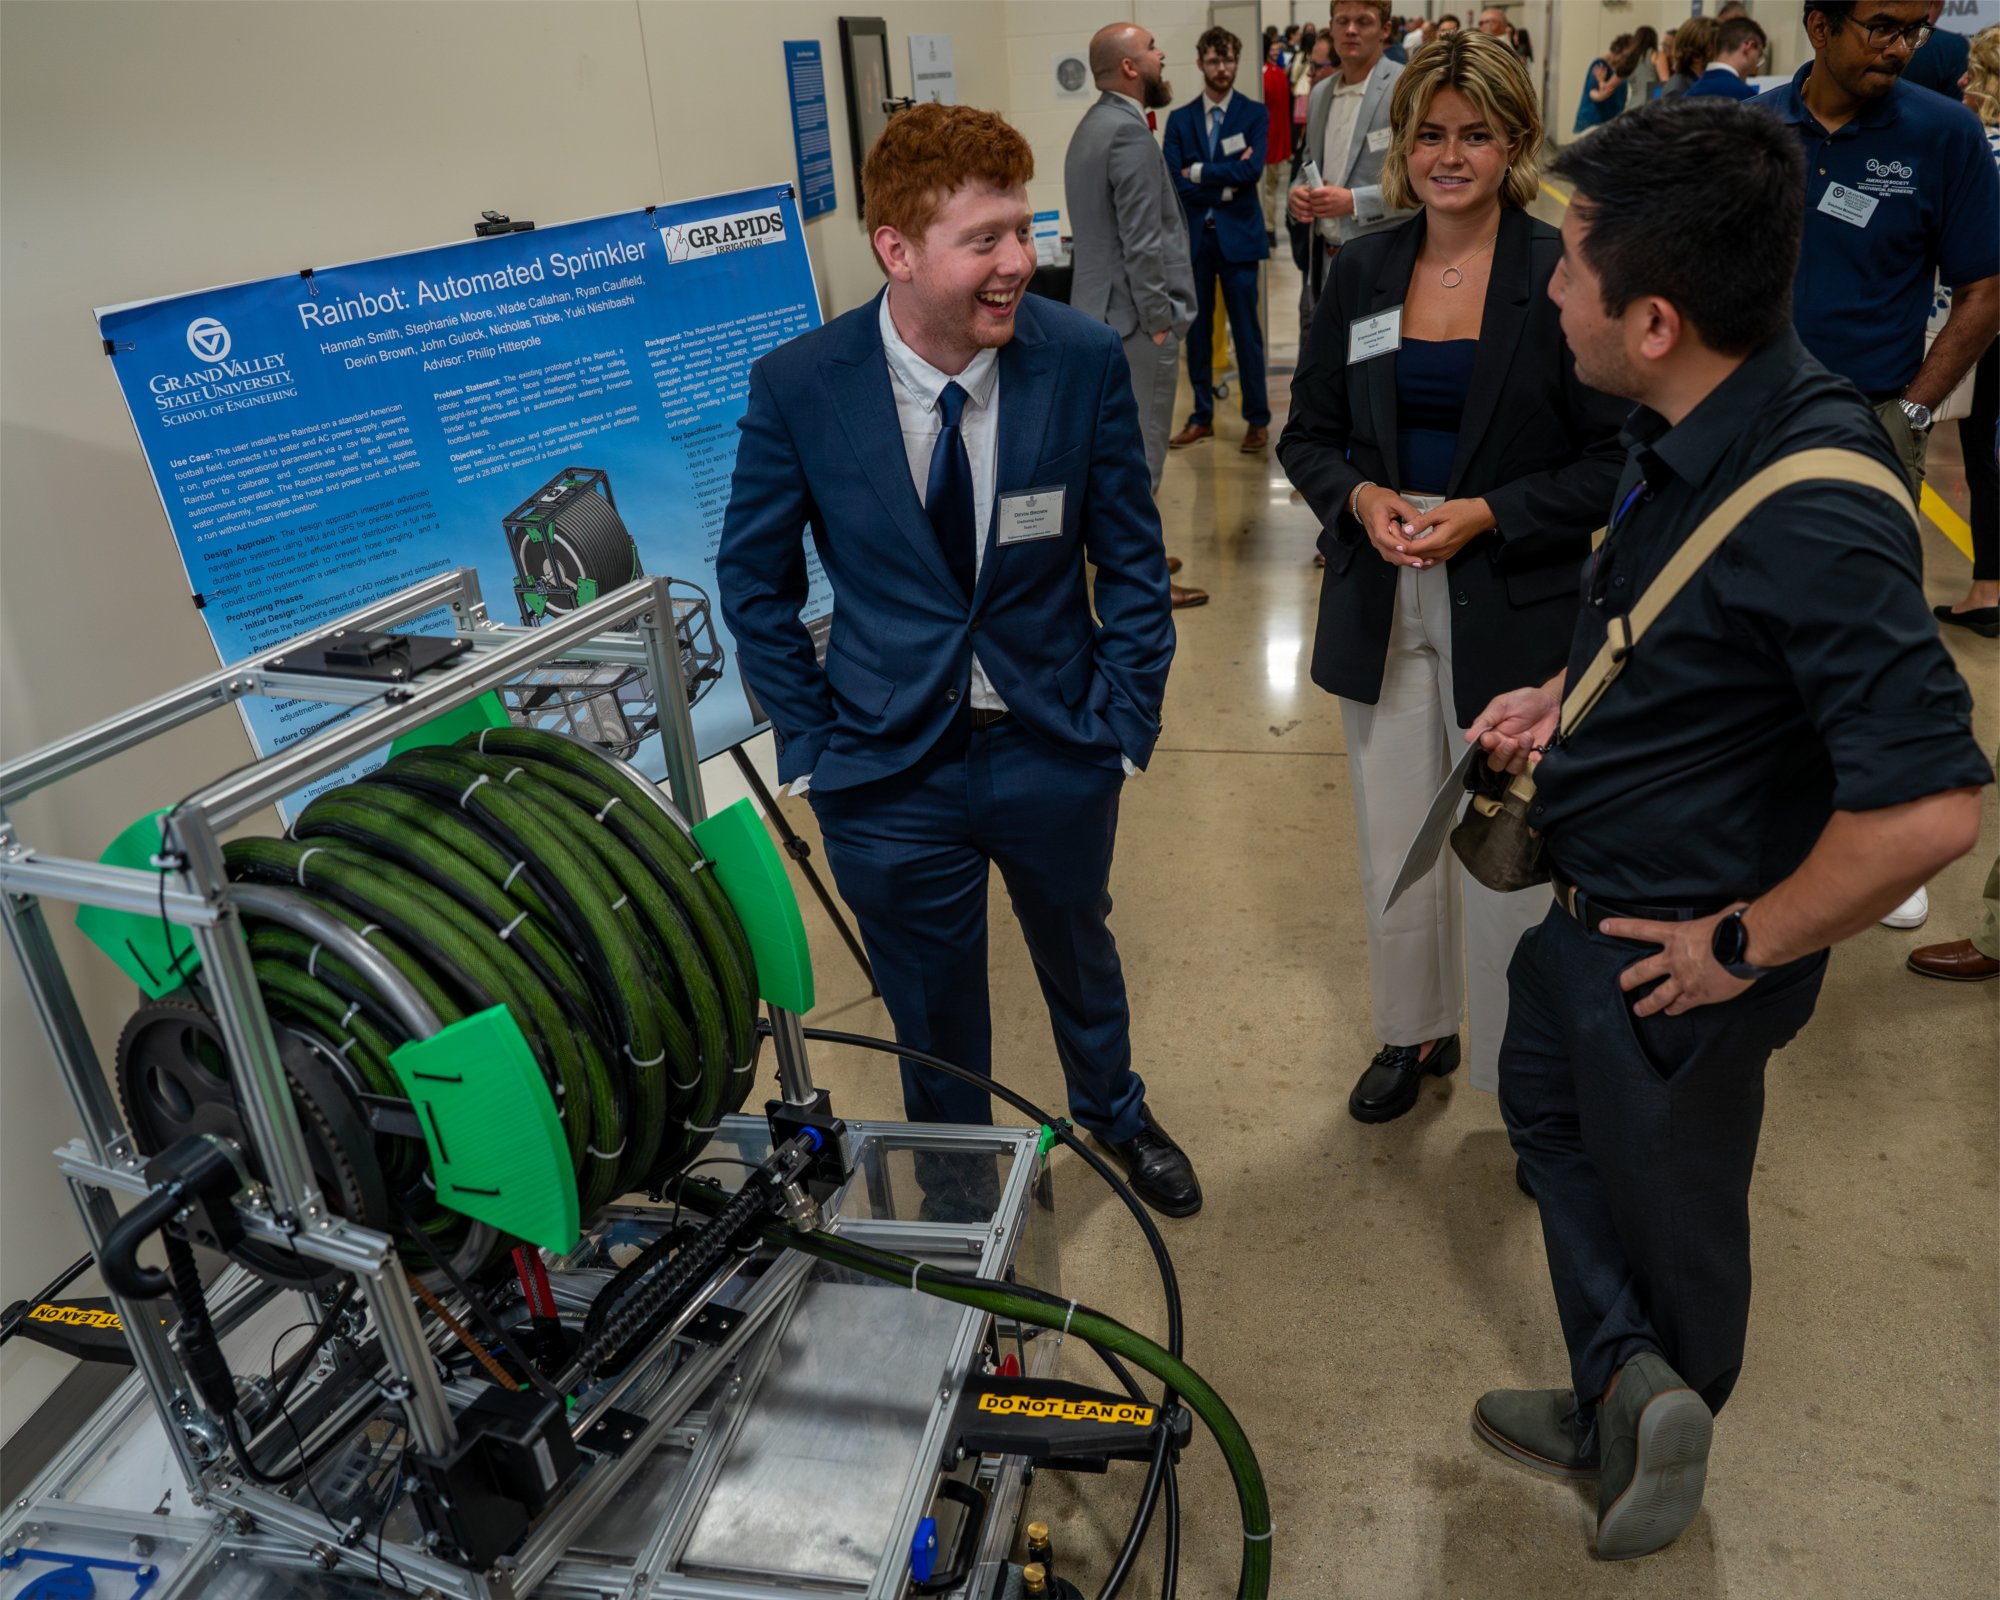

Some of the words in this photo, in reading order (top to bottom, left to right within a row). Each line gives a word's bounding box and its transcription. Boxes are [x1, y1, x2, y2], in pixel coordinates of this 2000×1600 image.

[1868, 160, 1912, 177] ASME
[688, 212, 784, 248] GRAPIDS
[716, 237, 763, 256] IRRIGATION
[297, 286, 411, 329] Rainbot:
[418, 257, 545, 305] Automated
[549, 240, 646, 279] Sprinkler
[319, 335, 366, 354] Hannah
[404, 315, 459, 335] Stephanie
[496, 301, 527, 315] Wade
[575, 285, 601, 299] Ryan
[344, 354, 378, 369] Devin
[420, 338, 447, 352] John
[488, 319, 532, 336] Nicholas
[563, 305, 586, 318] Yuki
[586, 294, 635, 313] Nishibashi
[423, 354, 466, 372] Advisor:
[466, 346, 496, 361] Philip
[497, 336, 542, 354] Hittepole
[149, 368, 223, 394] GRAND
[218, 353, 286, 378] VALLEY
[156, 389, 203, 412] STATE
[162, 408, 209, 427] SCHOOL
[210, 404, 226, 416] OF
[227, 387, 298, 412] ENGINEERING
[169, 459, 188, 468] Use
[188, 452, 214, 463] Case:
[214, 447, 231, 456] The
[231, 442, 249, 452] user
[250, 435, 277, 447] installs
[277, 432, 290, 440] the
[290, 424, 321, 436] Rainbot
[338, 411, 369, 425] standard
[370, 404, 403, 416] American
[174, 466, 204, 480] football
[226, 453, 262, 467] connects
[279, 442, 300, 453] water
[301, 437, 317, 447] and
[331, 429, 353, 441] power
[380, 415, 406, 428] powers
[183, 491, 215, 505] Rainbot
[237, 477, 270, 490] calibrate
[276, 470, 291, 480] and
[297, 459, 336, 474] coordinate
[367, 445, 381, 455] and
[386, 438, 413, 449] initiates
[202, 473, 236, 488] provides
[237, 460, 280, 478] operational
[281, 449, 323, 467] parameters
[375, 430, 397, 440] allows
[188, 499, 237, 517] autonomous
[277, 483, 293, 492] The
[294, 474, 324, 487] Rainbot
[324, 465, 359, 479] navigates
[360, 461, 372, 469] the
[392, 449, 417, 461] applies
[192, 518, 214, 529] water
[255, 497, 290, 512] manages
[291, 493, 304, 501] the
[304, 488, 324, 497] hose
[325, 482, 340, 492] and
[340, 476, 362, 489] power
[383, 466, 398, 475] and
[203, 531, 218, 539] run
[218, 522, 247, 535] without
[247, 515, 274, 527] human
[203, 548, 233, 561] Design
[236, 534, 279, 551] Approach:
[280, 529, 296, 537] The
[225, 603, 274, 623] Prototyping
[273, 593, 304, 607] Phases
[244, 617, 267, 630] Initial
[267, 609, 297, 622] Design:
[299, 591, 347, 612] Development
[356, 582, 373, 593] CAD
[374, 575, 400, 587] models
[400, 568, 414, 579] and
[414, 558, 451, 574] simulations
[274, 730, 298, 746] Future
[300, 712, 350, 734] Opportunities
[308, 777, 345, 797] Implement
[36, 1308, 58, 1319] ON
[60, 1312, 100, 1324] LEAN
[986, 1397, 1014, 1410] DO
[1018, 1400, 1059, 1413] NOT
[1062, 1404, 1114, 1418] LEAN
[1118, 1407, 1147, 1420] ON
